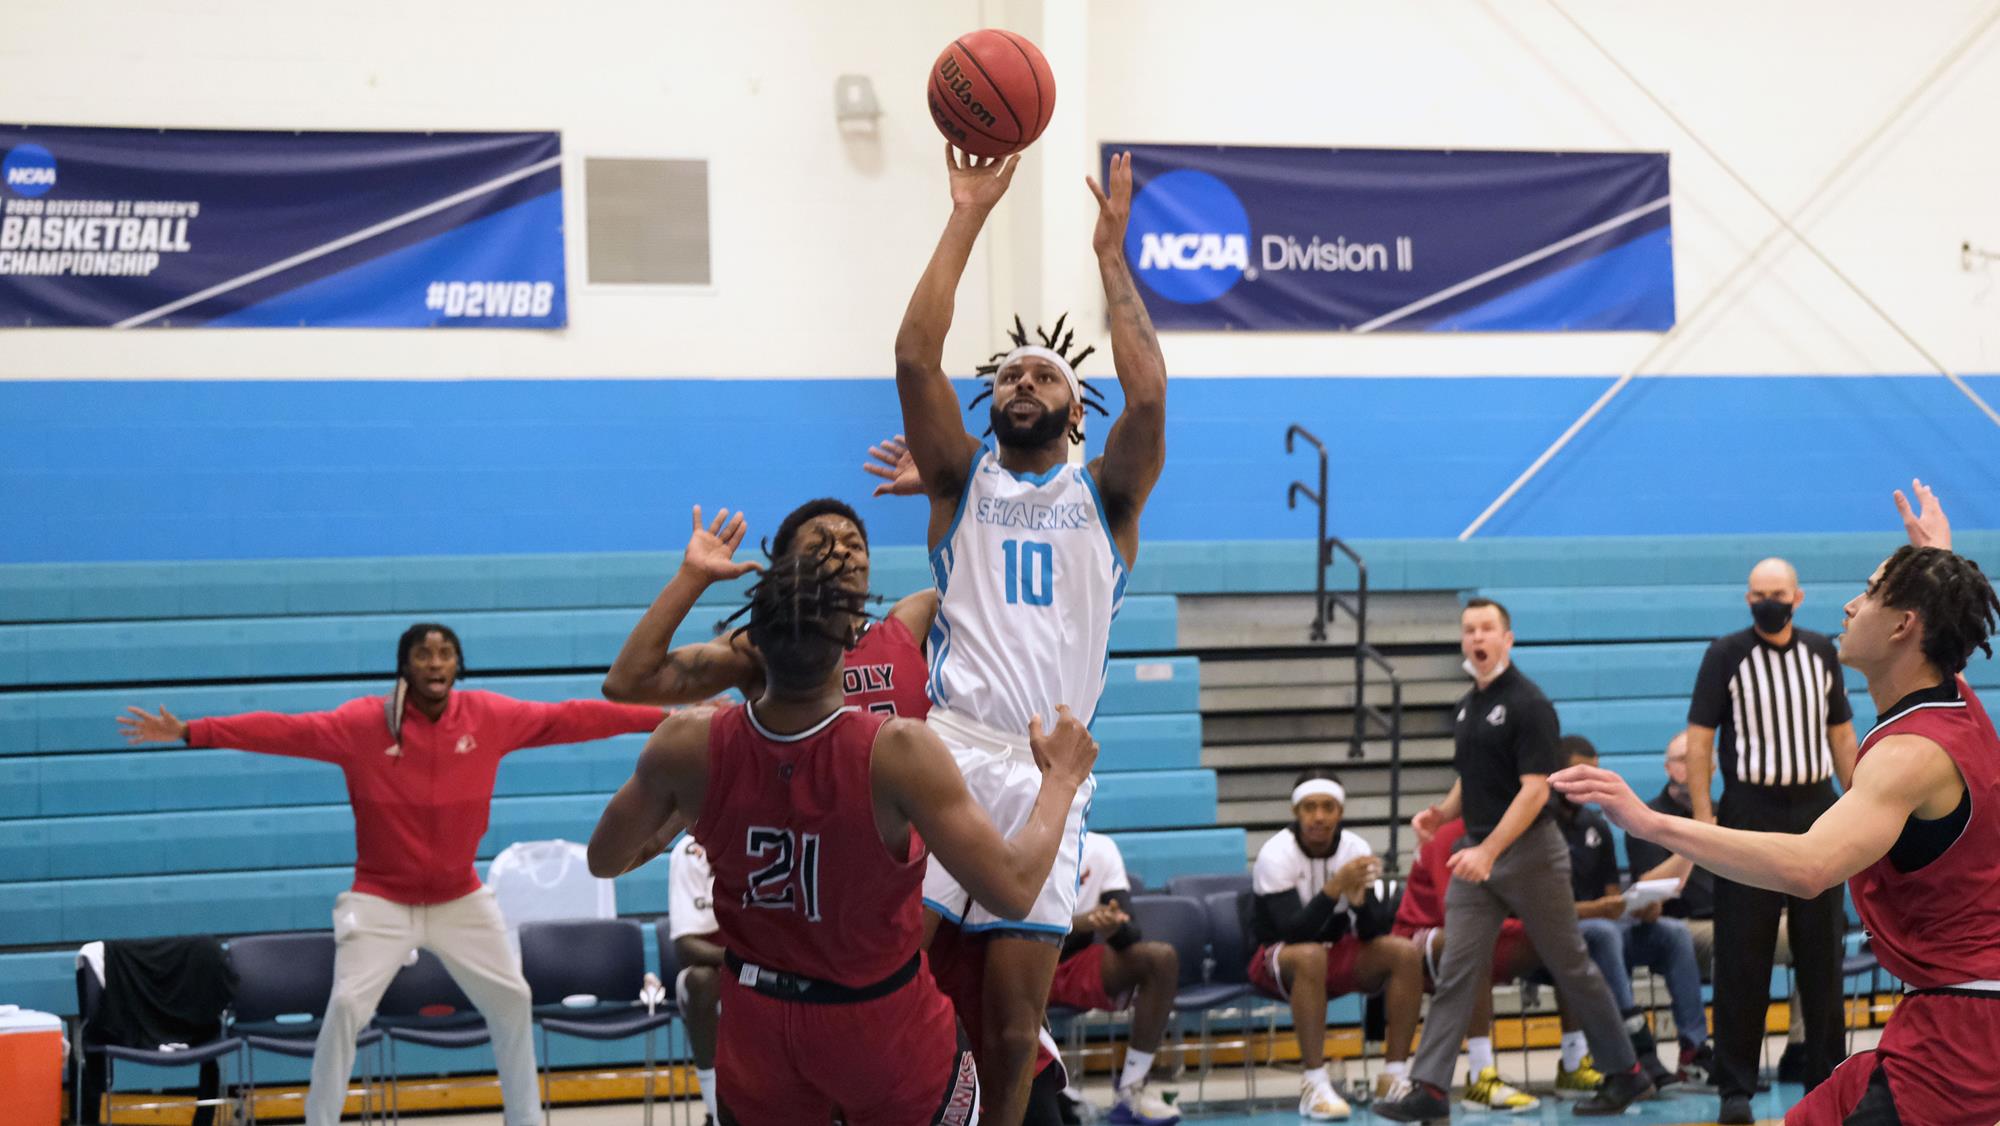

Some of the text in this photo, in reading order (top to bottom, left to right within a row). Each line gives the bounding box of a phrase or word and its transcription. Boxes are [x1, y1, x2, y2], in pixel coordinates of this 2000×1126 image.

[940, 54, 997, 128] Wilson
[7, 167, 57, 185] NCAA
[45, 200, 115, 217] DIVISION
[115, 201, 131, 217] II
[132, 201, 200, 218] WOMEN'S
[1, 216, 191, 252] BASKETBALL
[0, 252, 159, 276] CHAMPIONSHIP
[1139, 233, 1412, 272] NCAA Division II
[425, 281, 554, 317] #D2WBB
[975, 497, 1090, 531] SHARKS
[1002, 539, 1053, 606] 10
[843, 663, 894, 696] OLY
[742, 826, 821, 922] 21
[938, 1050, 976, 1126] AWKS
